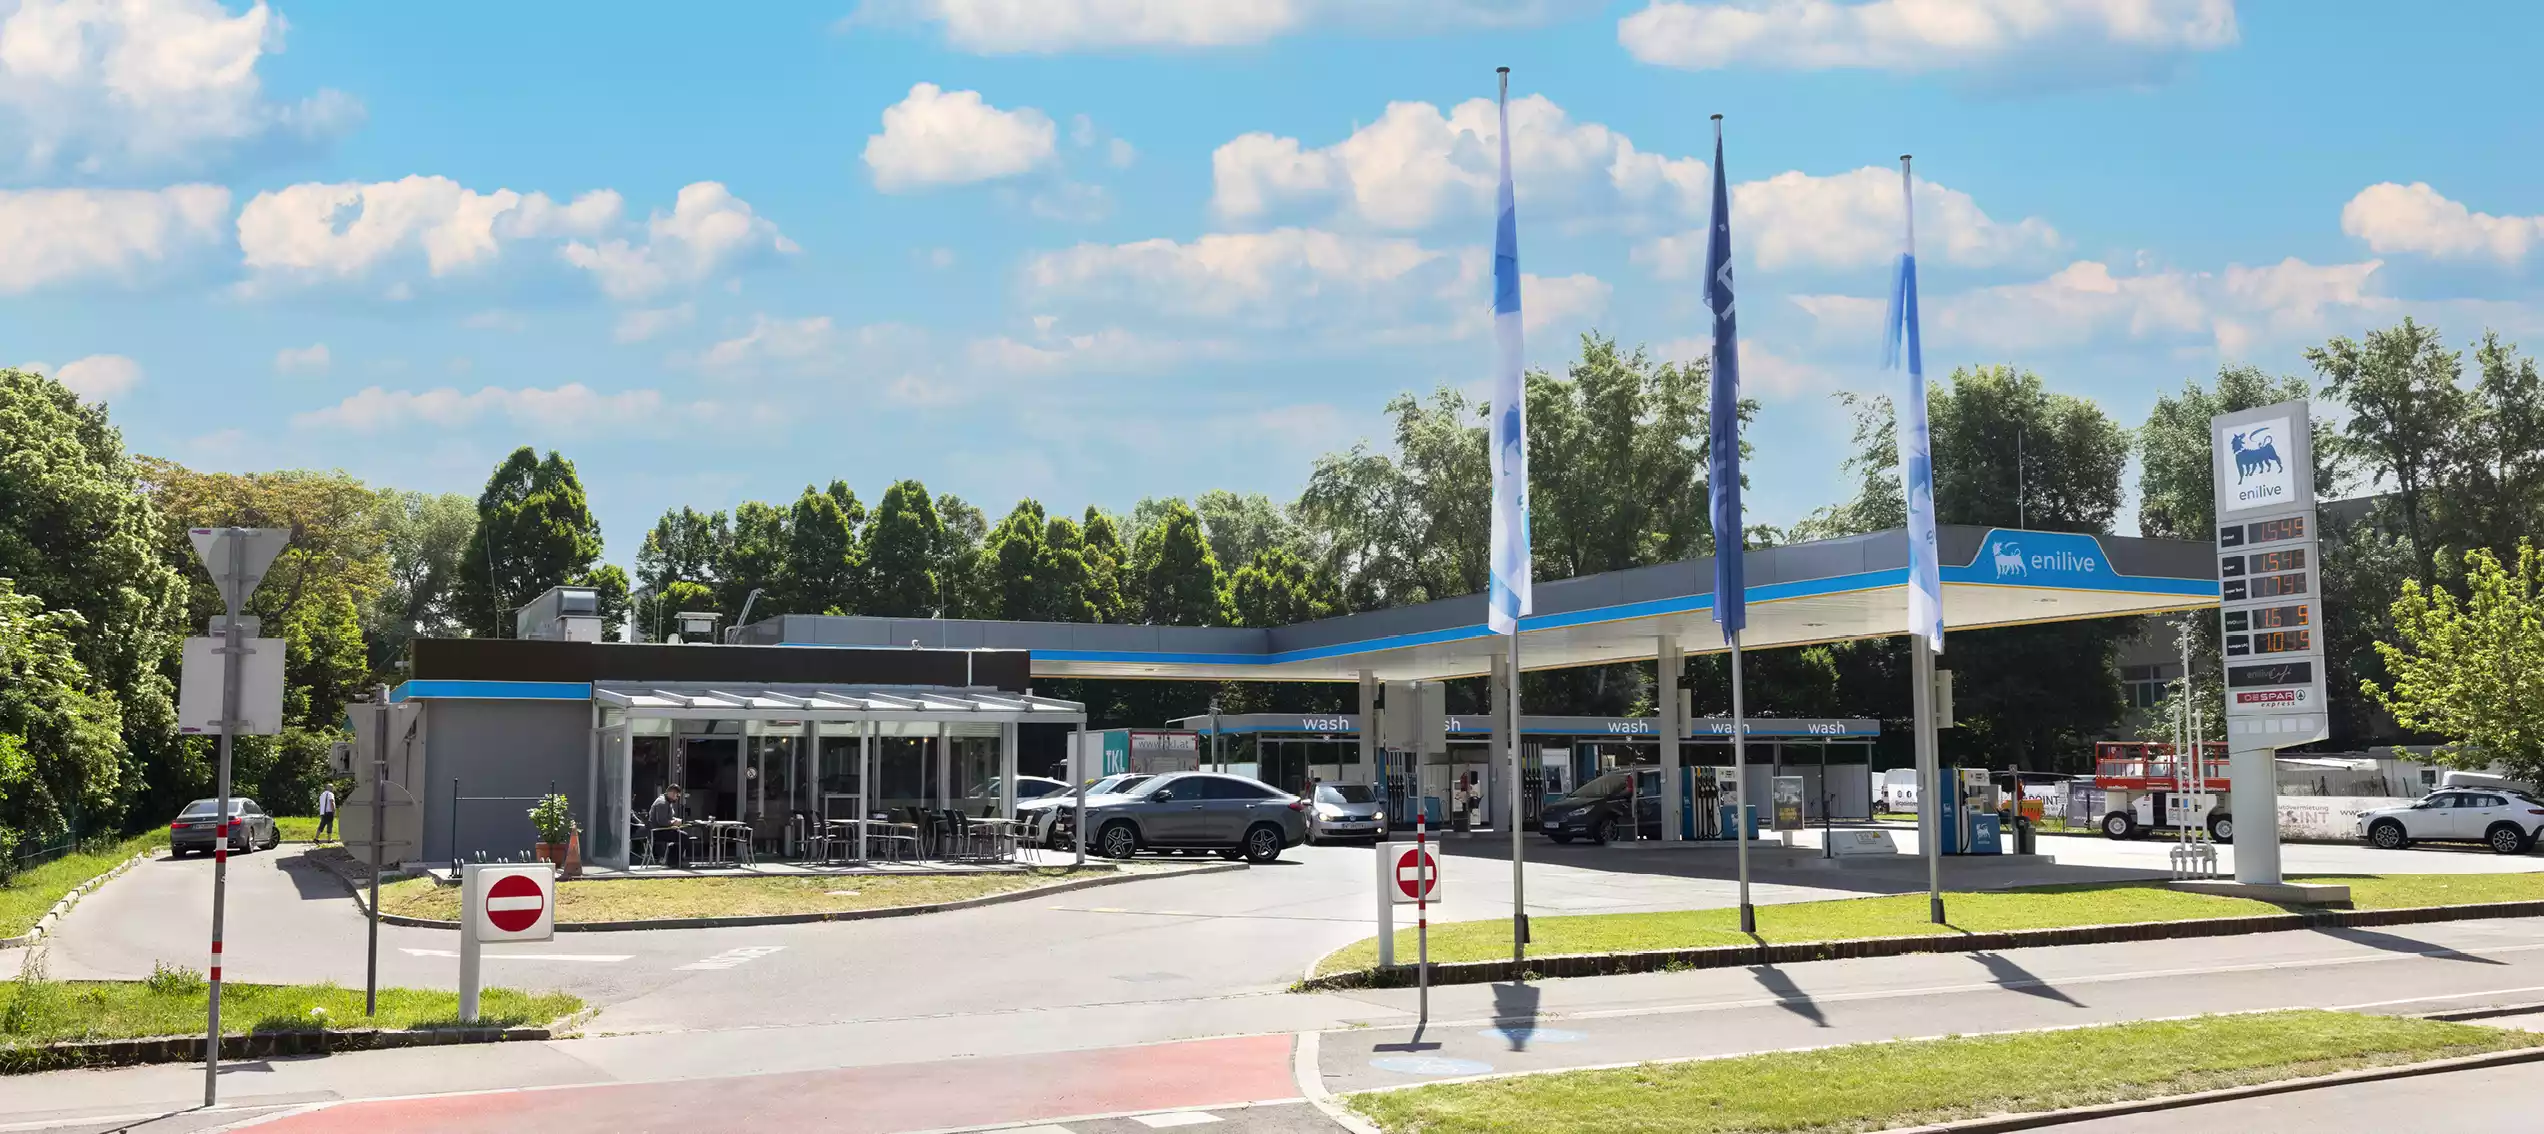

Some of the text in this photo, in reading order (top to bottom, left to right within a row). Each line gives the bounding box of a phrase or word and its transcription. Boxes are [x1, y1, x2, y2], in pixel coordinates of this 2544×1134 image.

[2239, 484, 2282, 501] enilive
[2031, 550, 2095, 572] enilive
[2261, 700, 2295, 708] express
[1302, 715, 1349, 731] wash
[1444, 716, 1461, 731] sh
[1607, 719, 1649, 734] wash
[1808, 720, 1846, 734] wash
[1105, 749, 1126, 773] TKL
[2278, 804, 2329, 812] utovermietung
